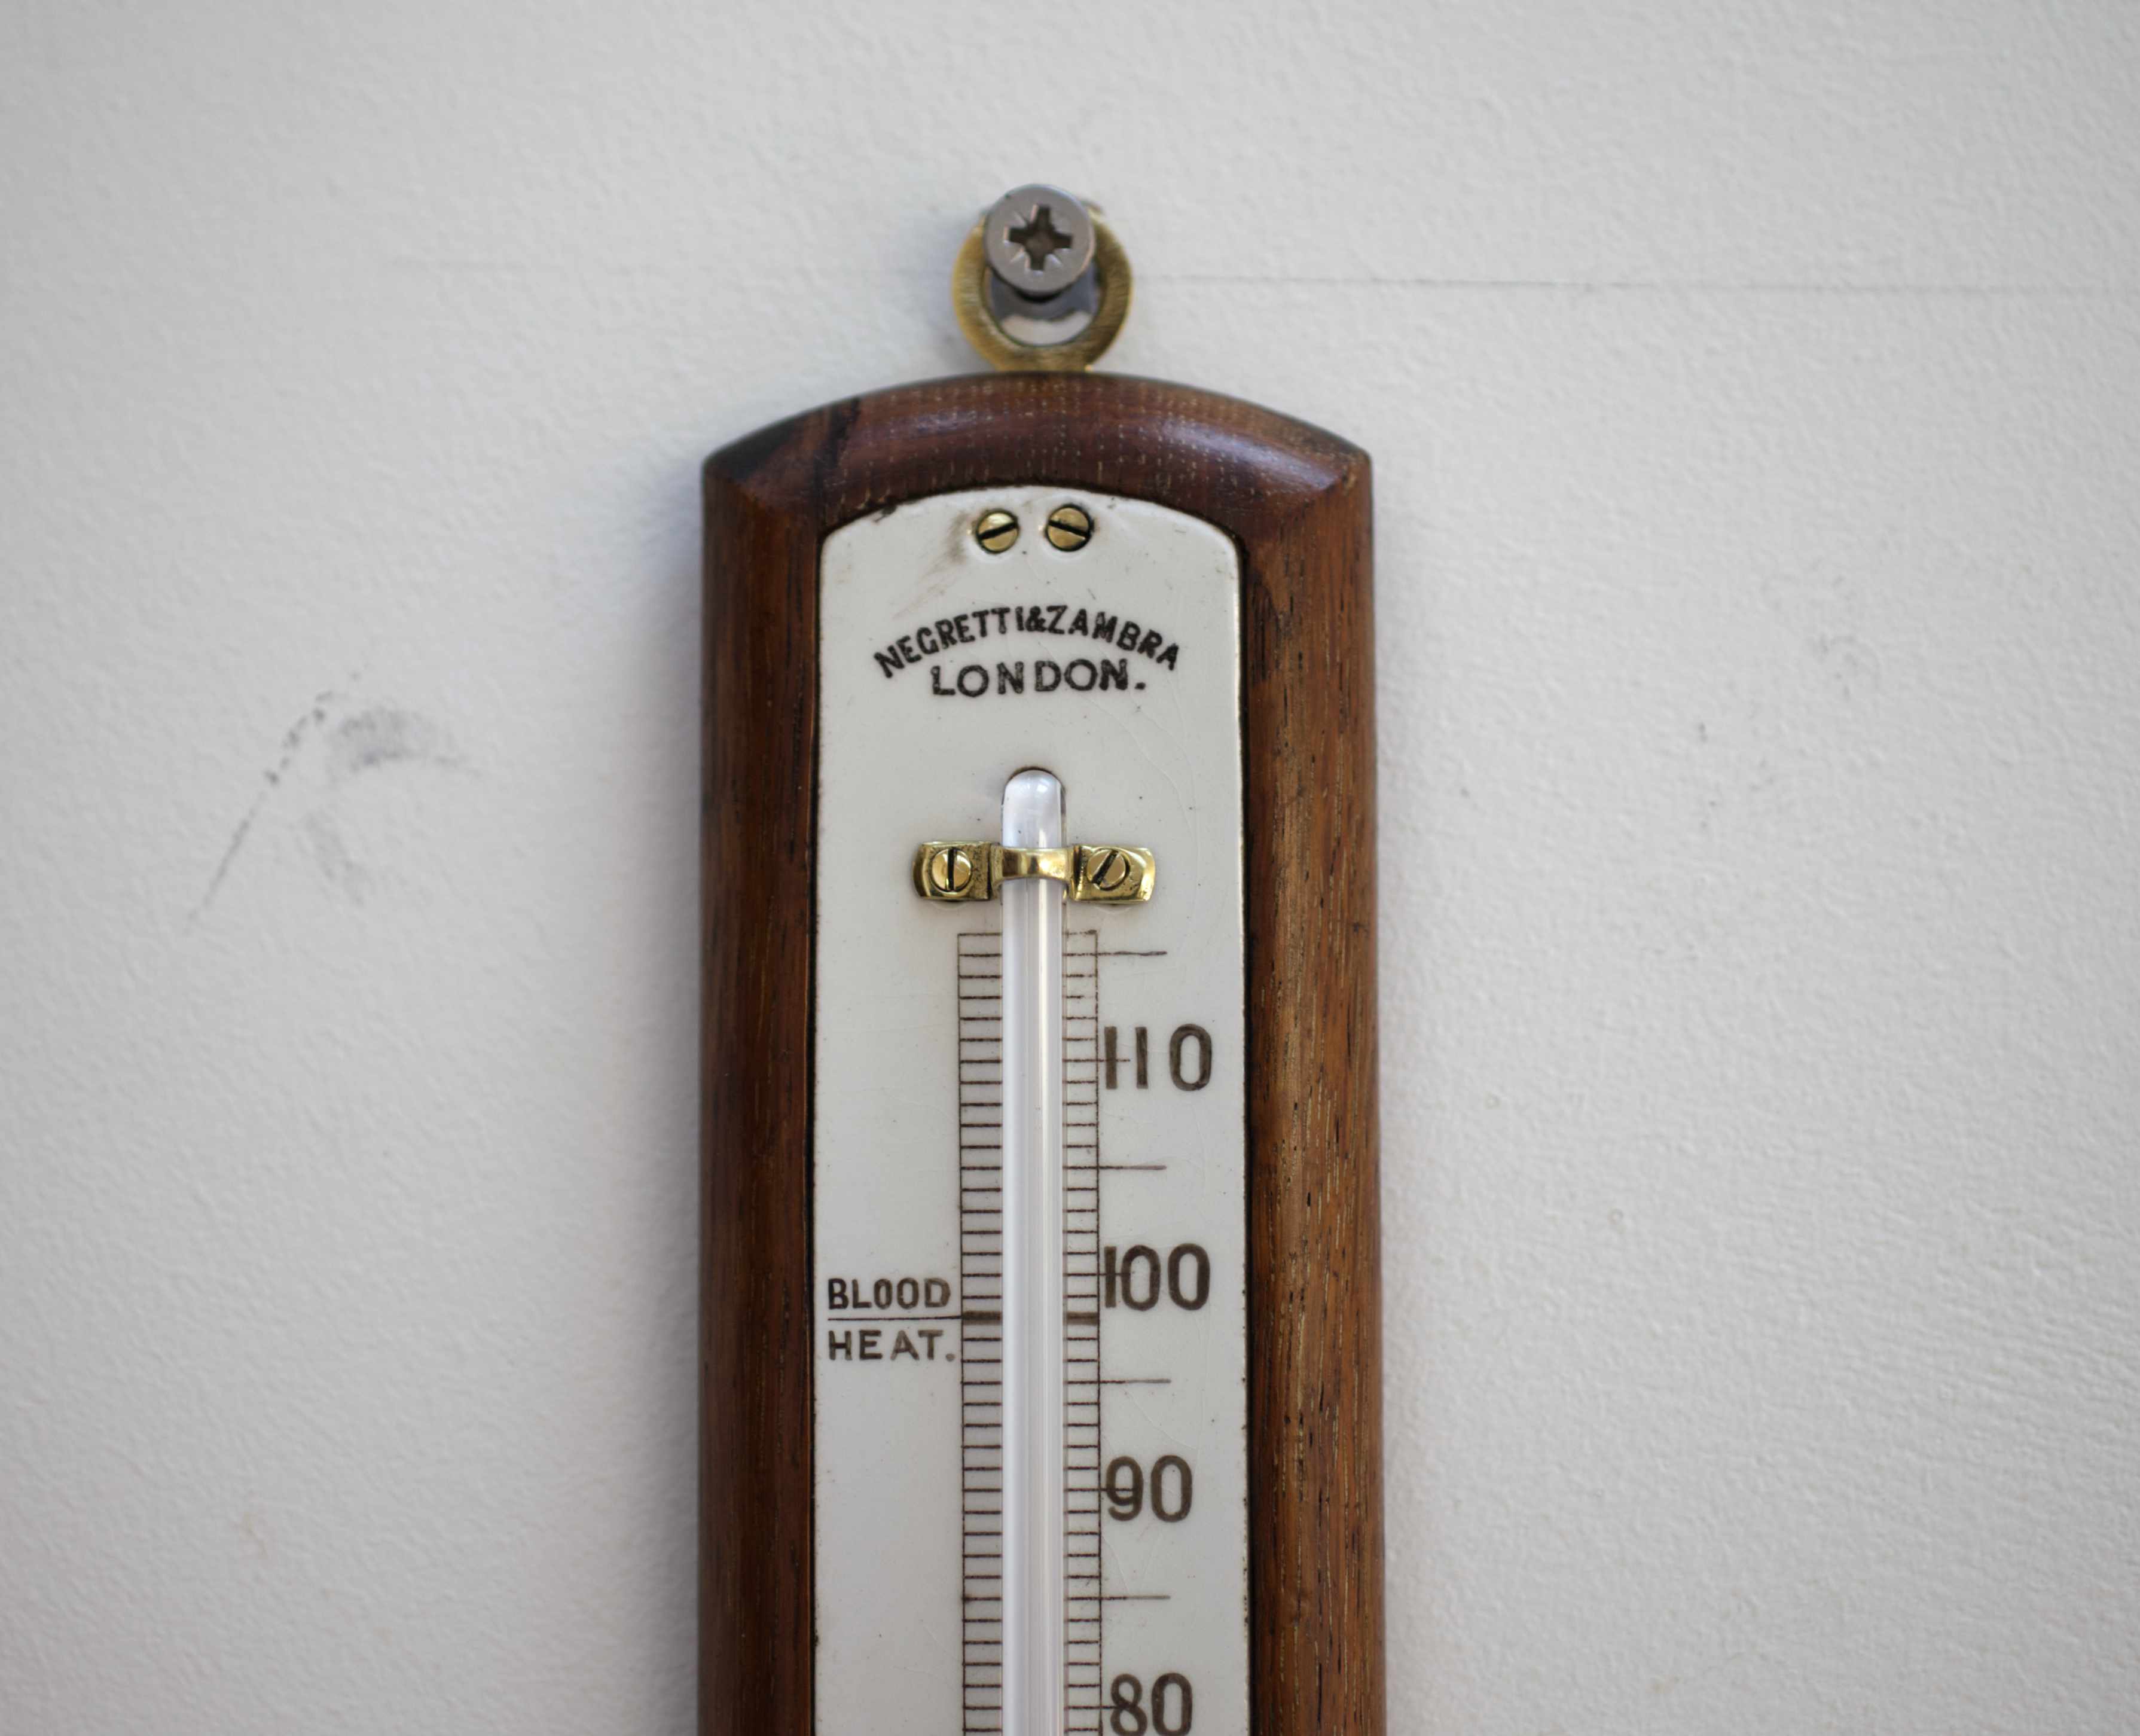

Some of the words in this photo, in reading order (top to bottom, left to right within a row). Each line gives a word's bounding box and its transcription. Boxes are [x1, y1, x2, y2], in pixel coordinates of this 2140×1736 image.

[930, 658, 1146, 697] LONDON.
[1104, 1024, 1212, 1091] 110
[828, 1278, 951, 1310] BLOOD
[1104, 1243, 1210, 1311] 100
[828, 1329, 955, 1362] HEAT.
[1106, 1455, 1193, 1523] 90
[1110, 1673, 1193, 1736] 80
